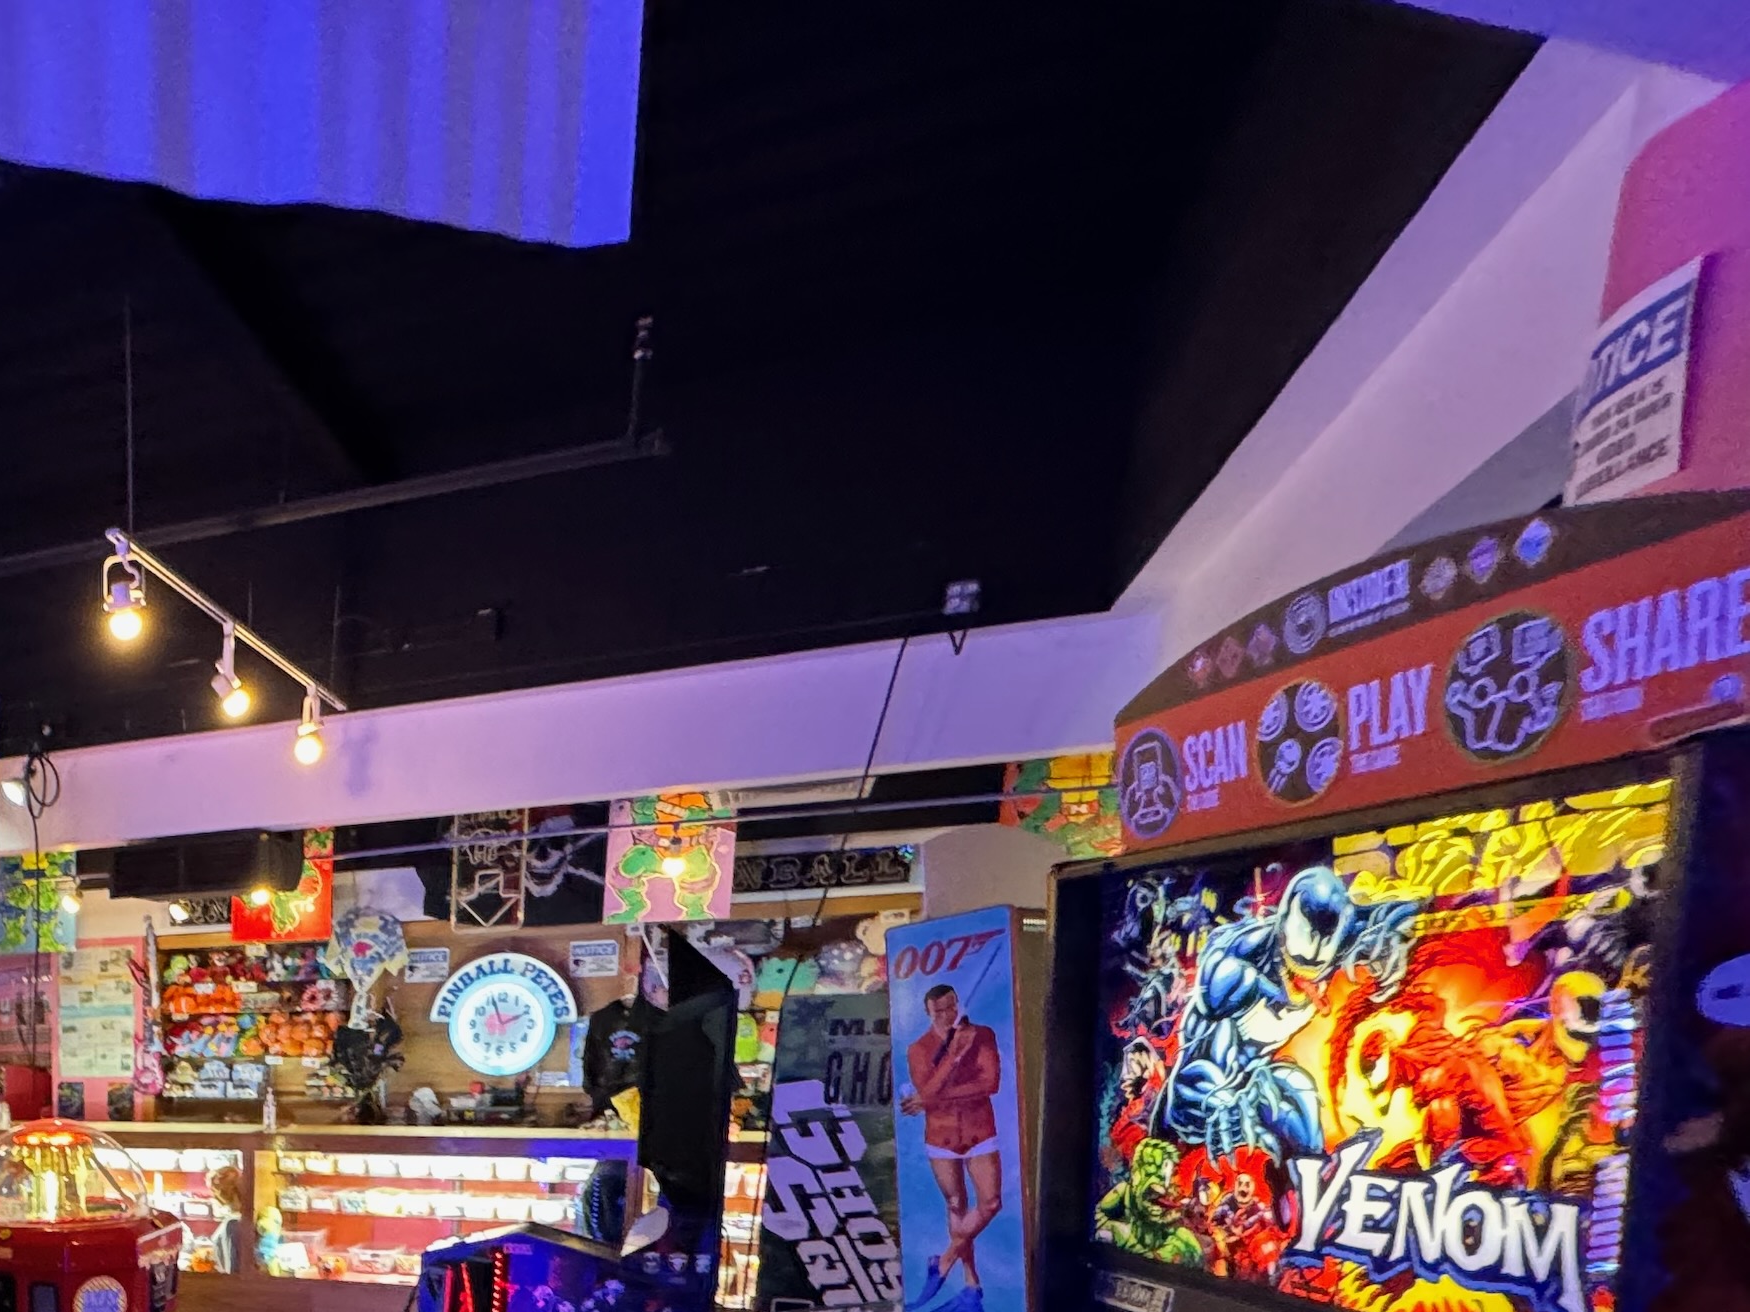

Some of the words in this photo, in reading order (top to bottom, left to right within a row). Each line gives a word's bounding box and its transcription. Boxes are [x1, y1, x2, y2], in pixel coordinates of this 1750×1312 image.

[1596, 296, 1688, 390] TICE
[1579, 567, 1750, 693] SHARE
[1348, 663, 1435, 752] PLAY
[1183, 720, 1248, 792] SCAN
[734, 851, 906, 890] NBALL
[437, 958, 515, 1019] PINBALL
[894, 930, 995, 979] 007
[772, 1080, 902, 1301] GHOS
